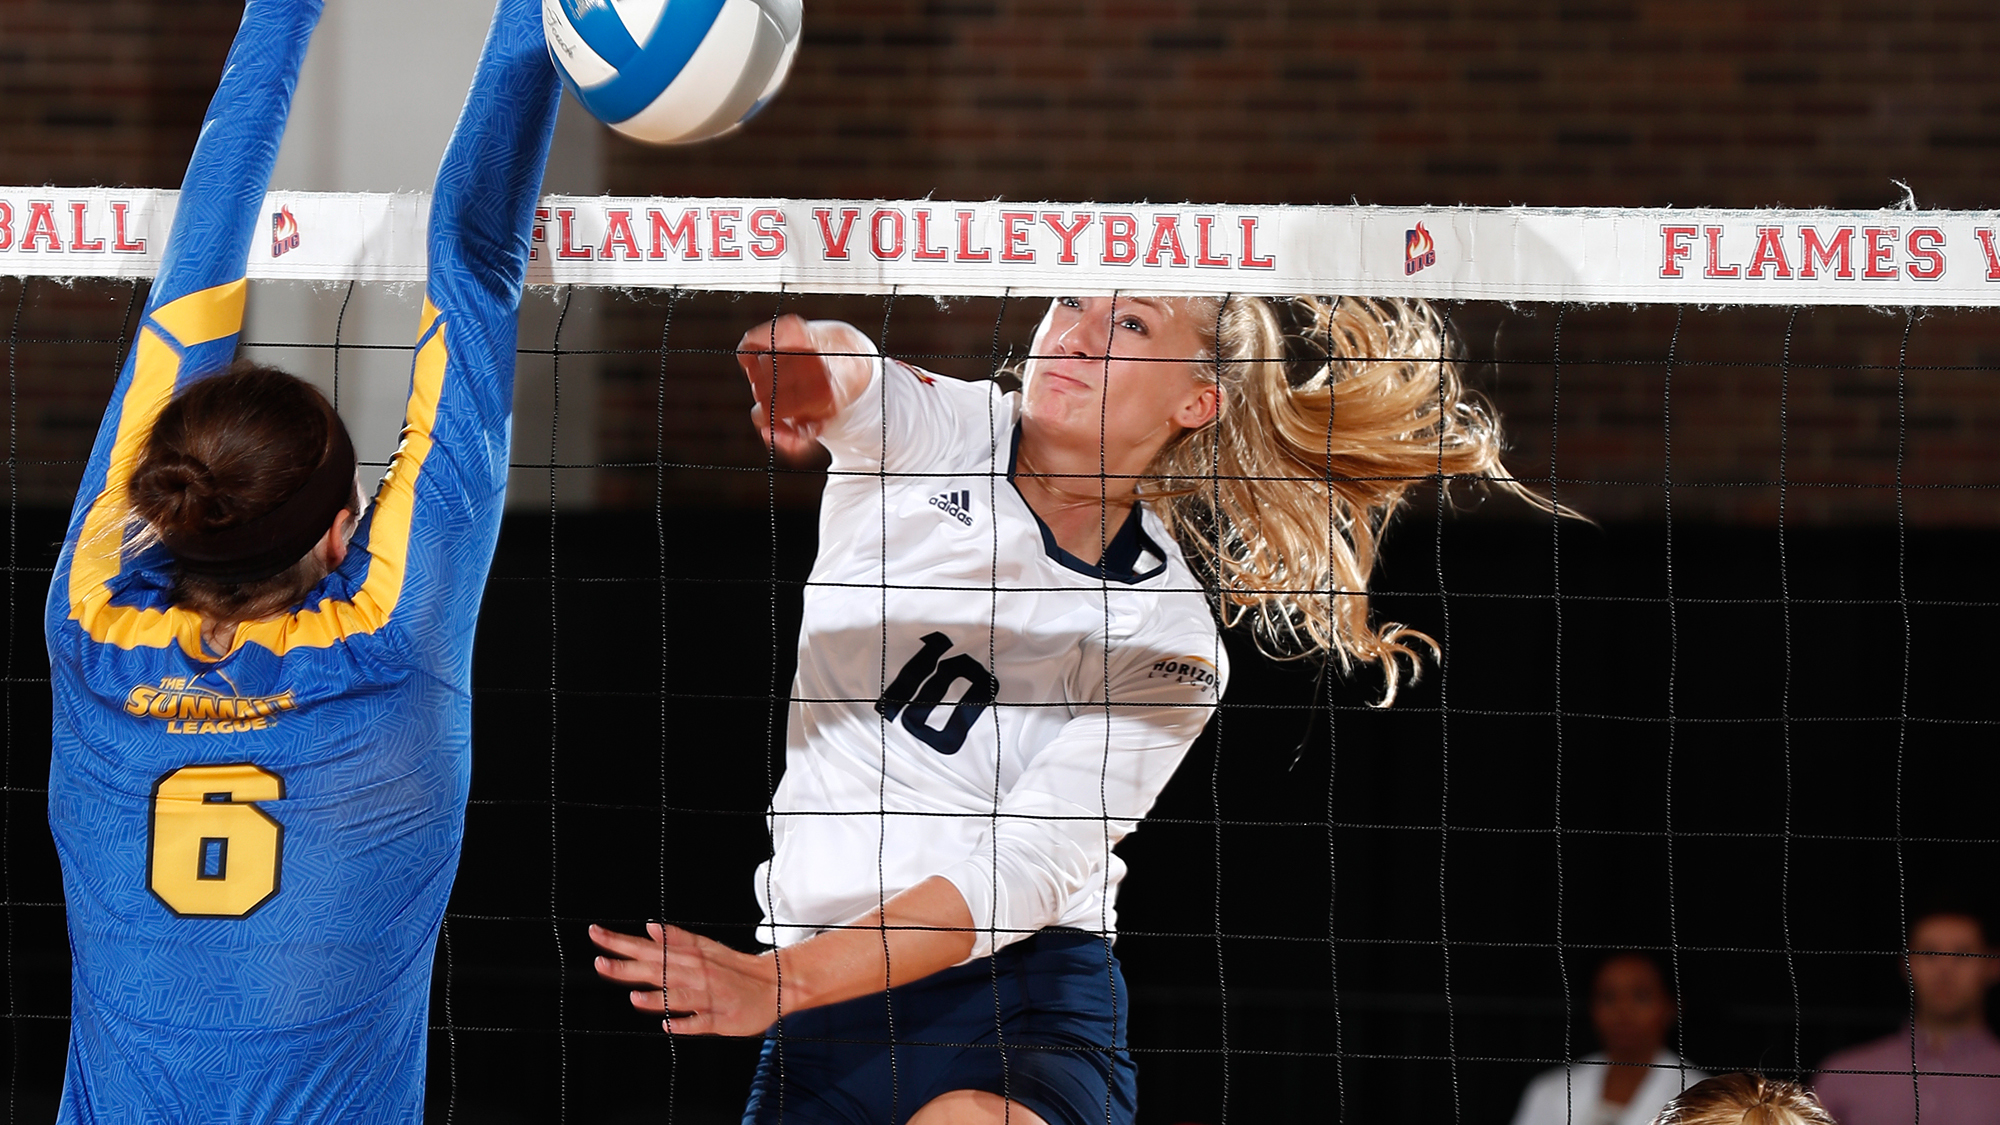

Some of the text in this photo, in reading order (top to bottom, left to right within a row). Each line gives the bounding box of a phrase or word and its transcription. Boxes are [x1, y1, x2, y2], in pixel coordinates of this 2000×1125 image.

[812, 207, 1276, 271] VOLLEYBALL
[1659, 224, 1947, 282] FLAMES
[1405, 250, 1436, 276] UIC
[928, 497, 973, 527] adidas
[159, 677, 187, 690] THE
[874, 631, 999, 755] 10
[166, 717, 268, 735] LEAGUE
[145, 762, 287, 921] 6
